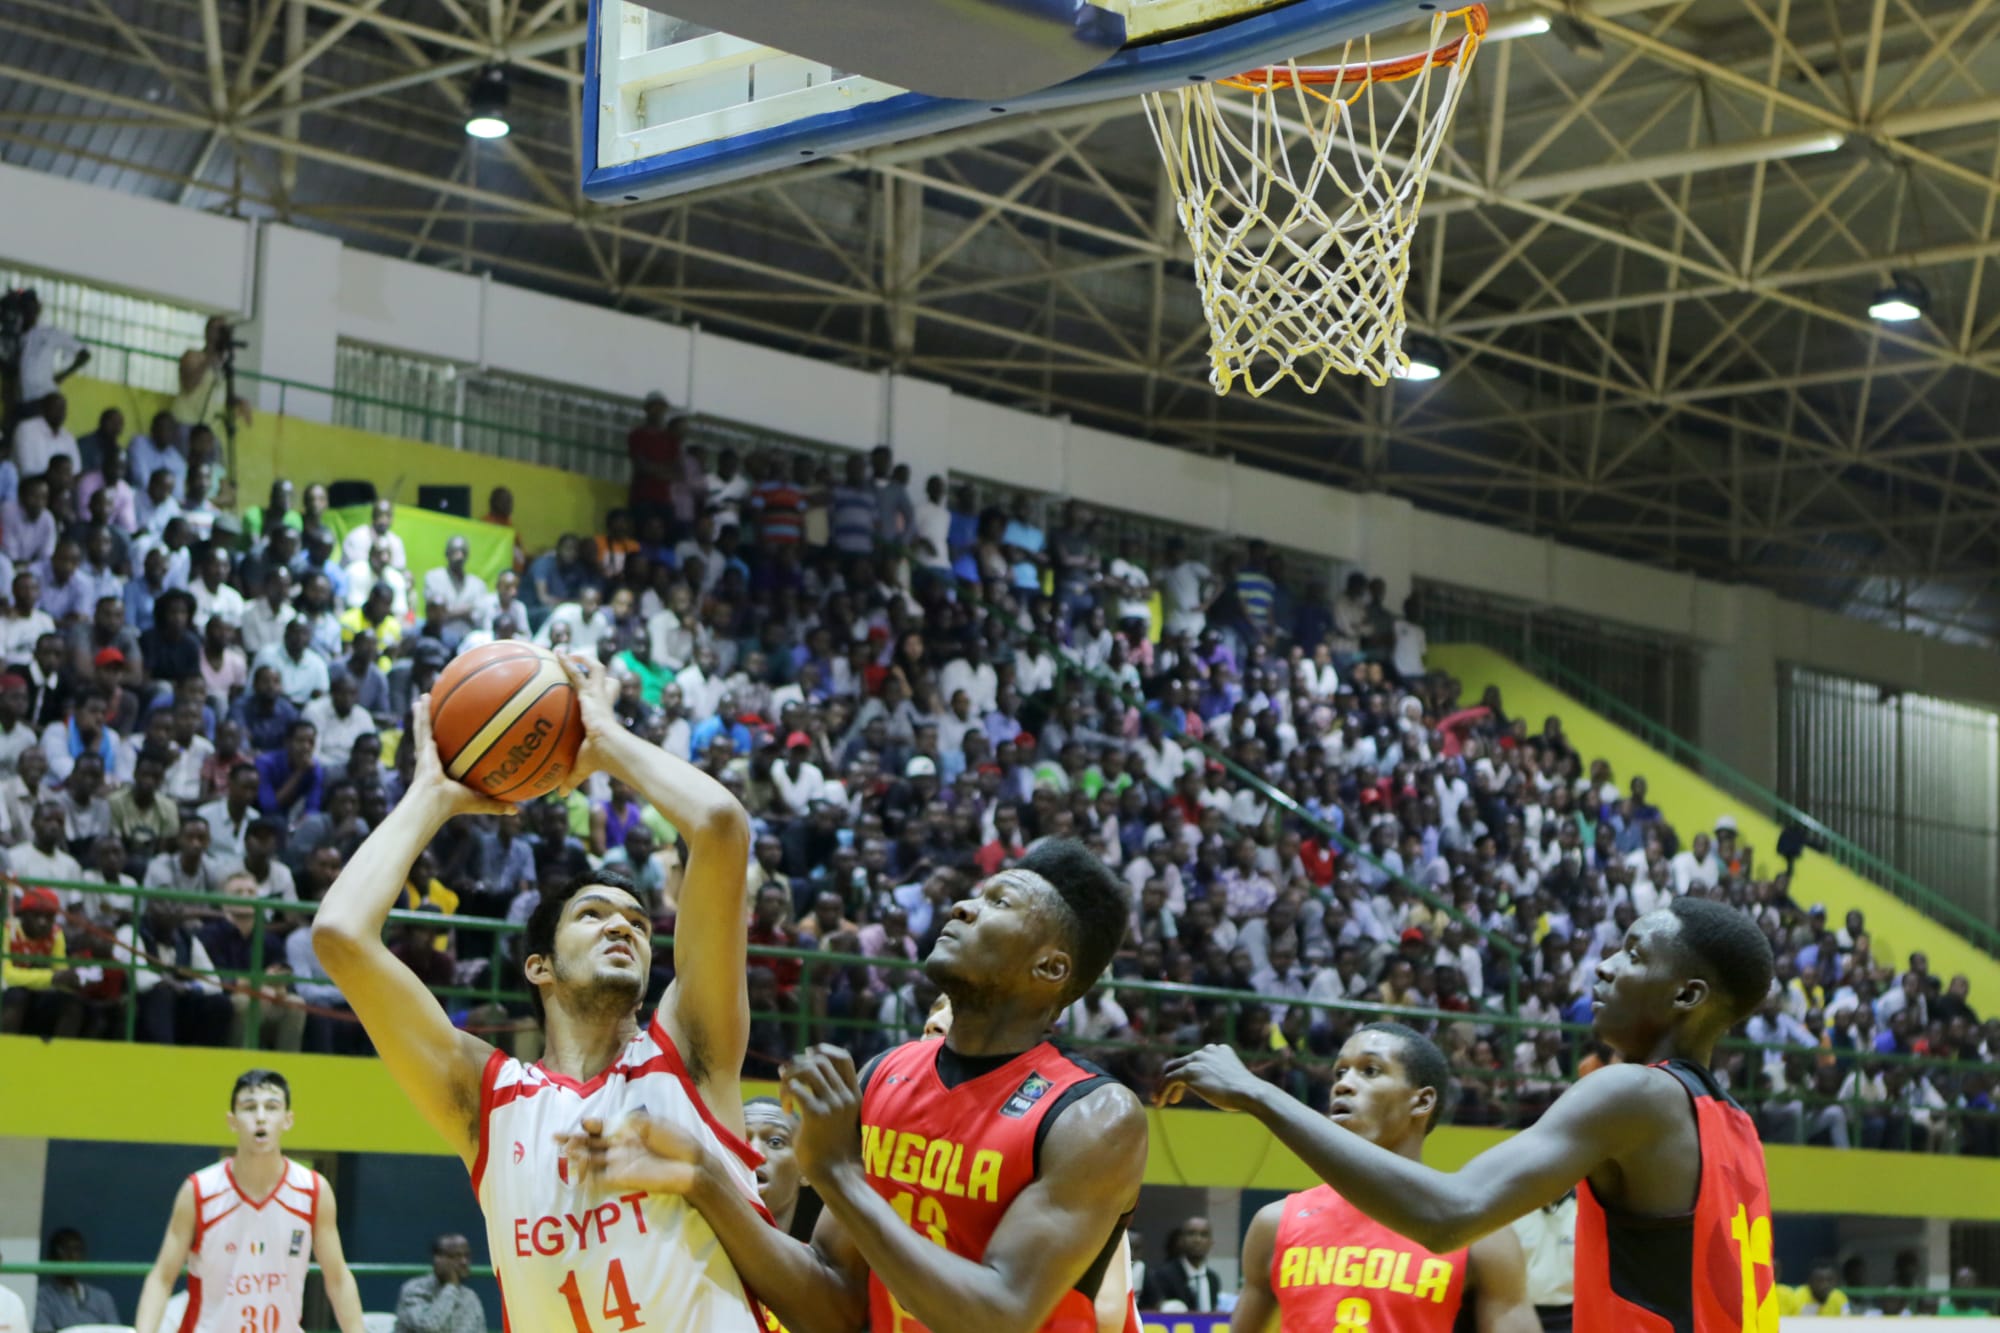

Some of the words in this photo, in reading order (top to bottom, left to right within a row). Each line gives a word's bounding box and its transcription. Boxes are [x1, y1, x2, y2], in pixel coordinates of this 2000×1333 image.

[482, 717, 553, 788] molten
[515, 1191, 648, 1257] EGYPT
[558, 1258, 647, 1333] 14
[1280, 1245, 1453, 1303] ANGOLA
[240, 1303, 280, 1333] 30
